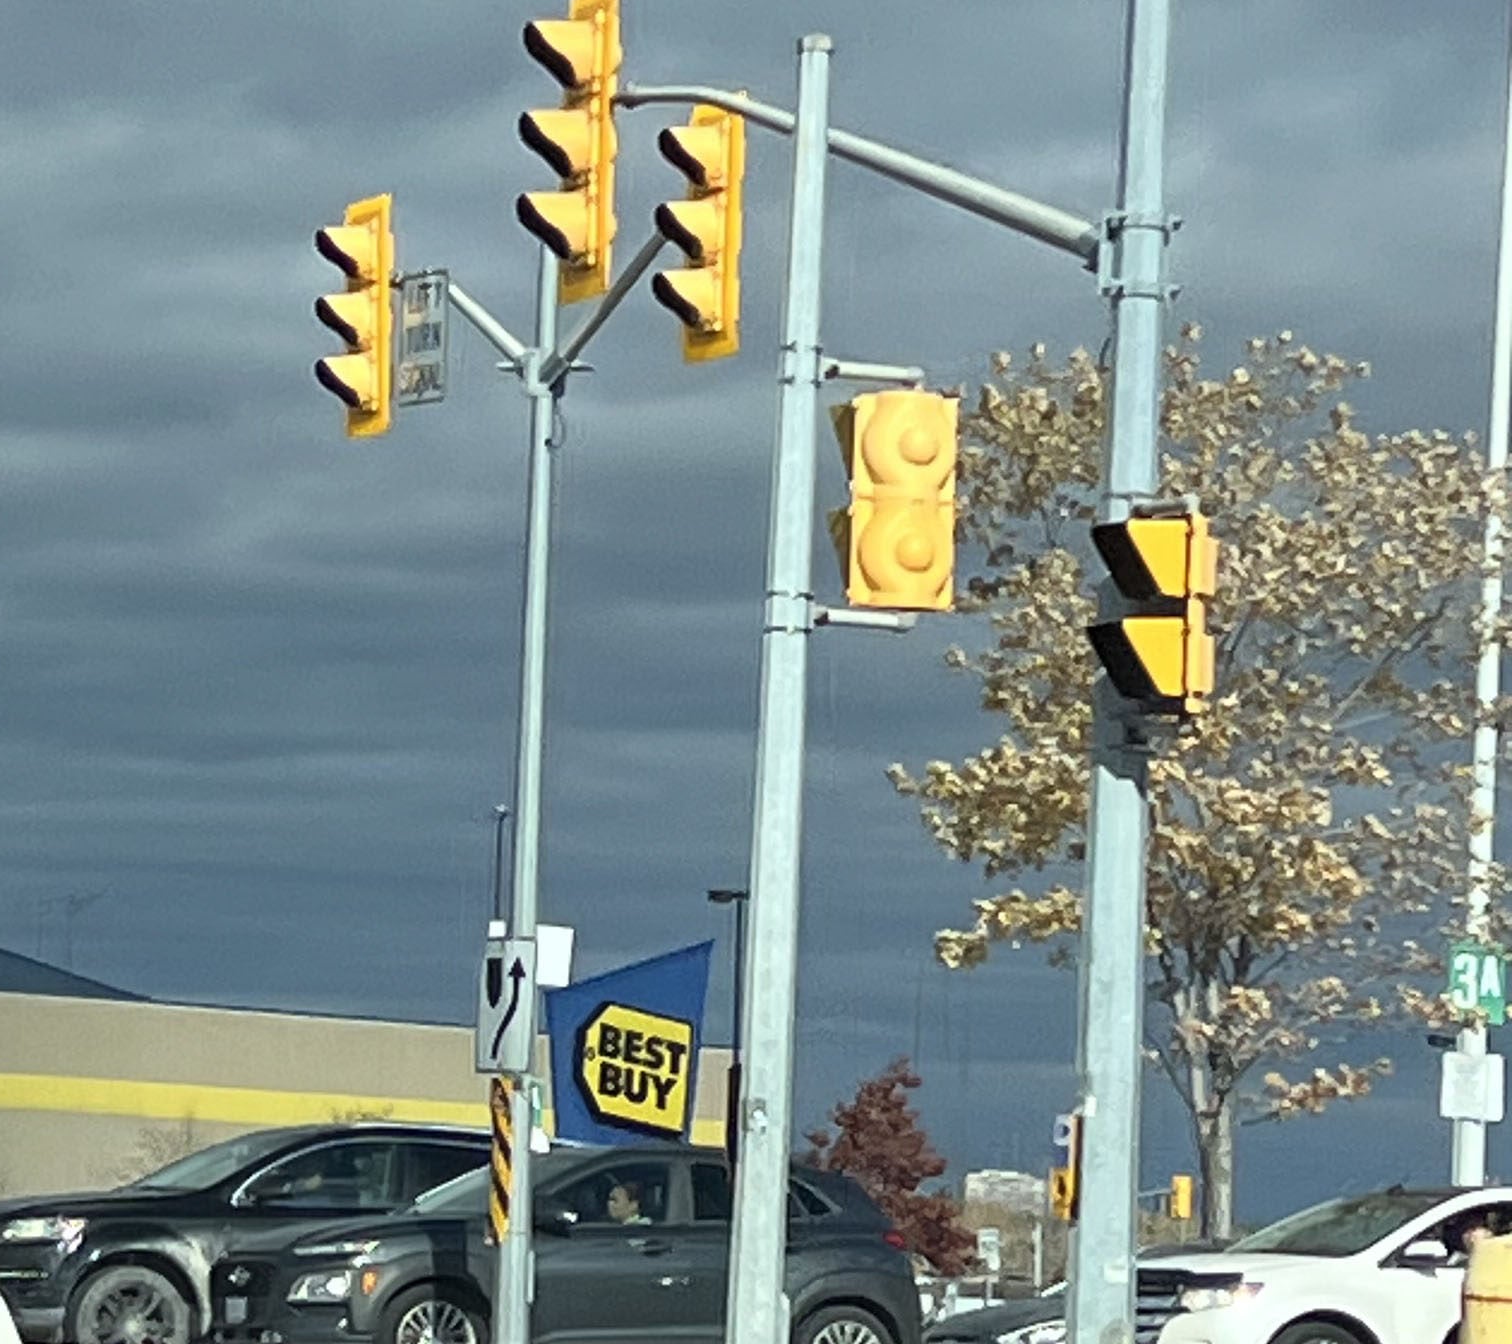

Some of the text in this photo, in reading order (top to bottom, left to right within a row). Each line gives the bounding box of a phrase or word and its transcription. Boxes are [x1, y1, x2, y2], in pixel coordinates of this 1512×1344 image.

[1452, 952, 1502, 1010] 3A
[597, 1022, 687, 1074] BEST
[597, 1061, 678, 1111] BUY
